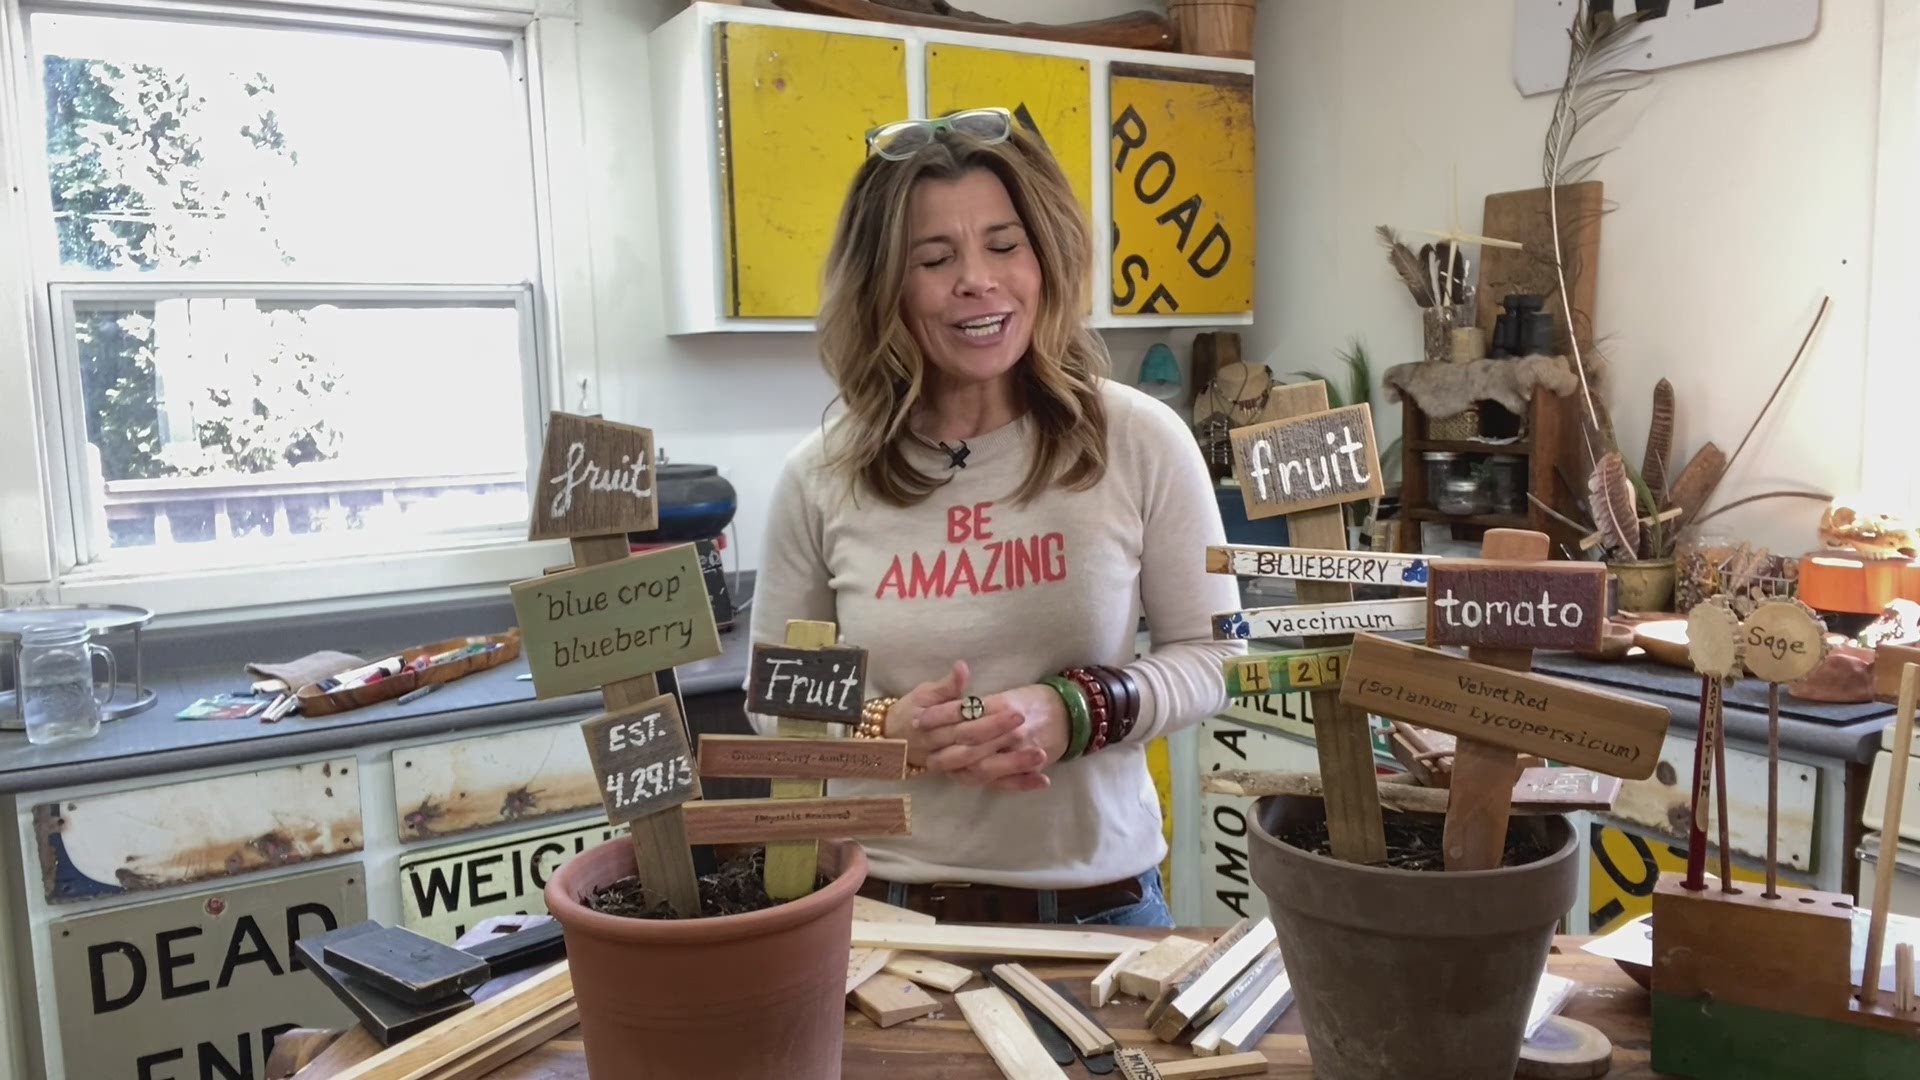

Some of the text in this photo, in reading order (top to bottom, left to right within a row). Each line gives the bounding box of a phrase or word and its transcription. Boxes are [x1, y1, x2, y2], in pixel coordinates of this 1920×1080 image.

[1113, 104, 1231, 279] ROAD
[550, 441, 652, 519] fruit
[1250, 426, 1371, 500] fruit
[947, 501, 994, 544] BE
[875, 532, 1067, 600] AMAZING
[1257, 551, 1389, 583] BLUEBERRY
[1266, 611, 1395, 634] vaccinium
[1434, 588, 1583, 628] tomato
[553, 618, 693, 669] blueberry
[1747, 625, 1807, 661] Sage
[764, 656, 859, 711] Fruit
[1246, 662, 1263, 690] 4
[1457, 675, 1549, 713] Velvet Red
[609, 712, 667, 752] EST.
[606, 755, 693, 808] 4.29.13
[87, 902, 339, 1015] DEAD
